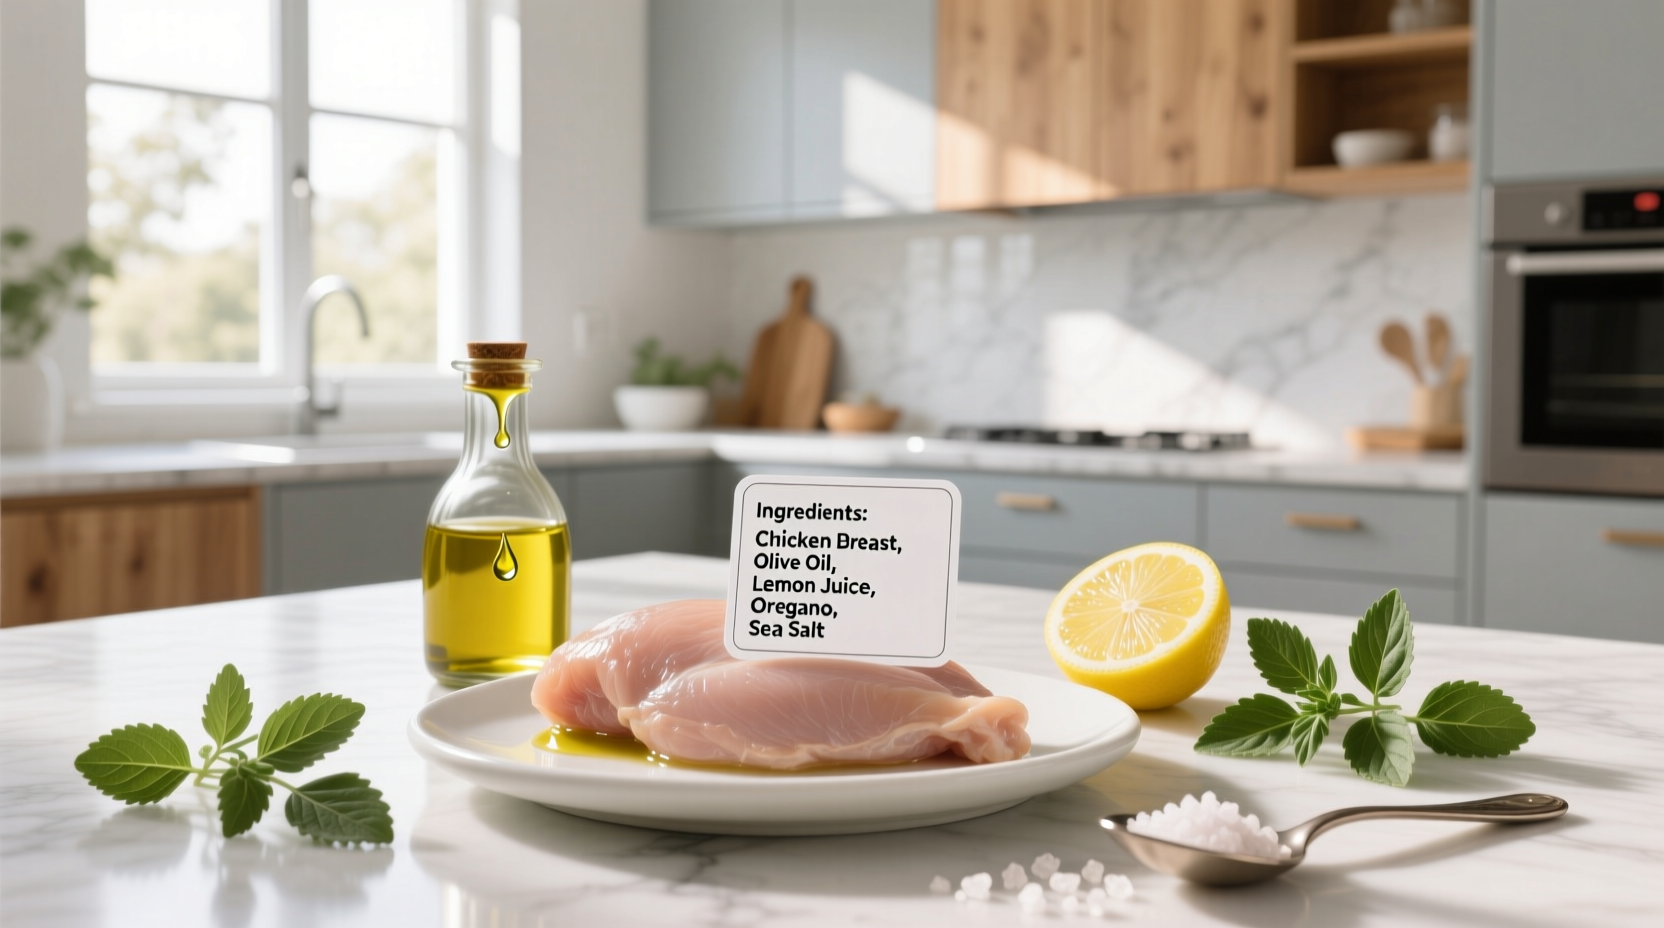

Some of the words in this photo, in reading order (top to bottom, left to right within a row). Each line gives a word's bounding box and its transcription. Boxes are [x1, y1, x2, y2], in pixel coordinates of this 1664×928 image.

[756, 502, 868, 523] Ingredients:
[755, 529, 832, 549] Chicken
[836, 532, 902, 555] Breast,
[753, 552, 801, 570] Olive
[805, 554, 837, 575] Oil,
[752, 575, 816, 593] Lemon
[820, 577, 876, 598] Juice,
[750, 596, 838, 619] Oregano,
[748, 619, 783, 637] Sea
[788, 620, 825, 638] Salt
